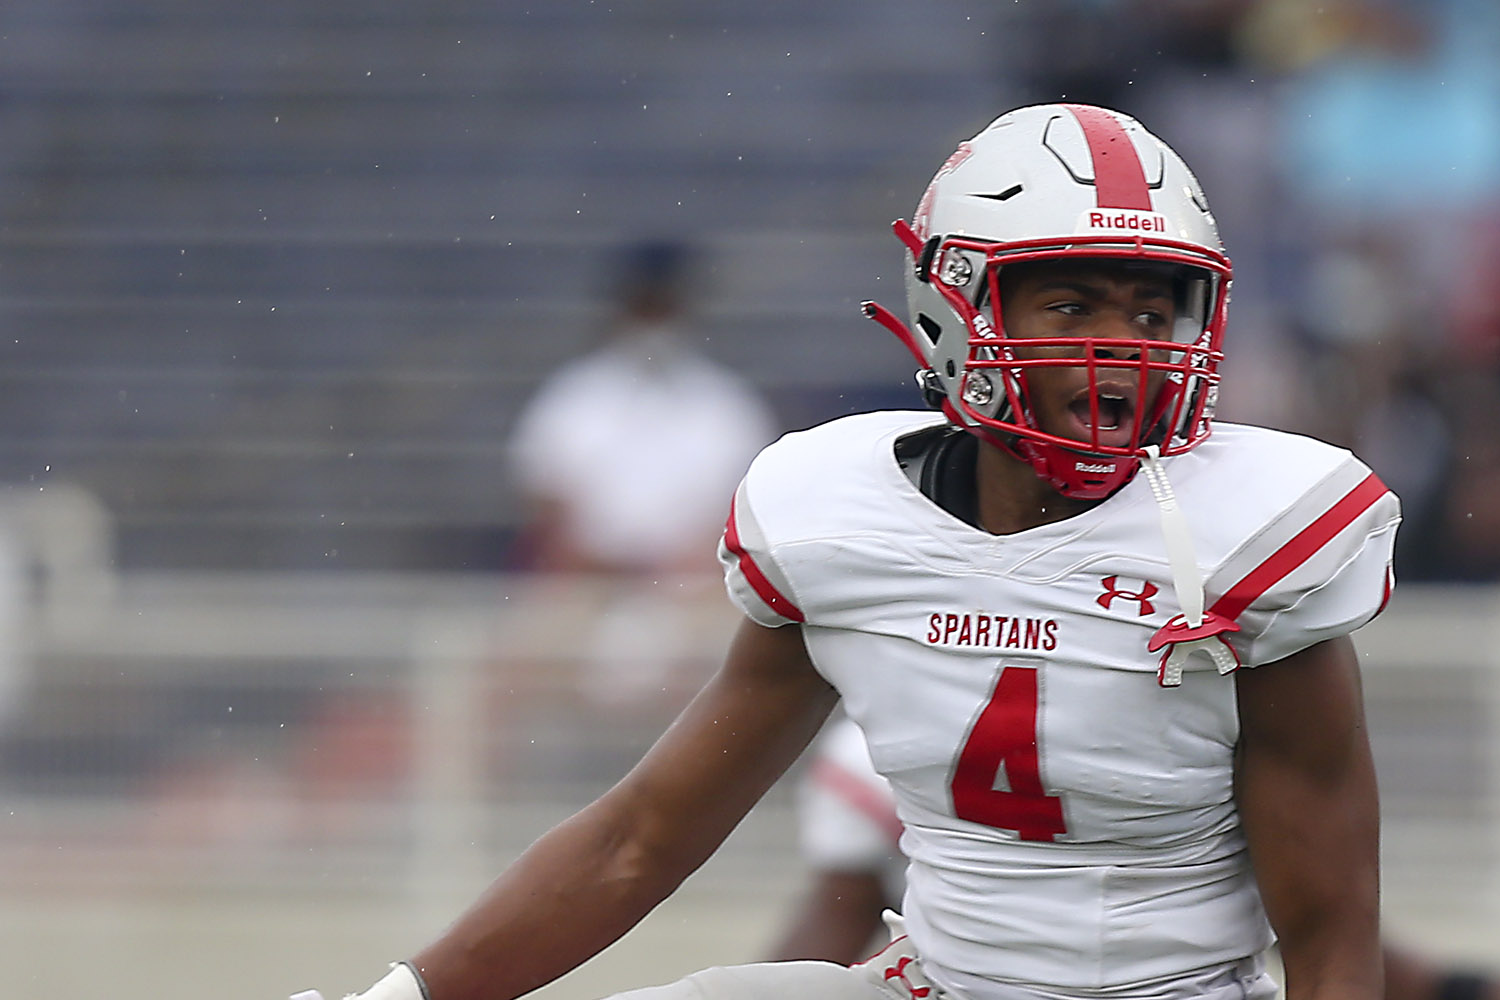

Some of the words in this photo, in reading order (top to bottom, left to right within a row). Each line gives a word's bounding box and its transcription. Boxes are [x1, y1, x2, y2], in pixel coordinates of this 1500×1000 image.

[1090, 212, 1165, 232] Riddell
[928, 613, 1059, 651] SPARTANS
[950, 665, 1067, 842] 4
